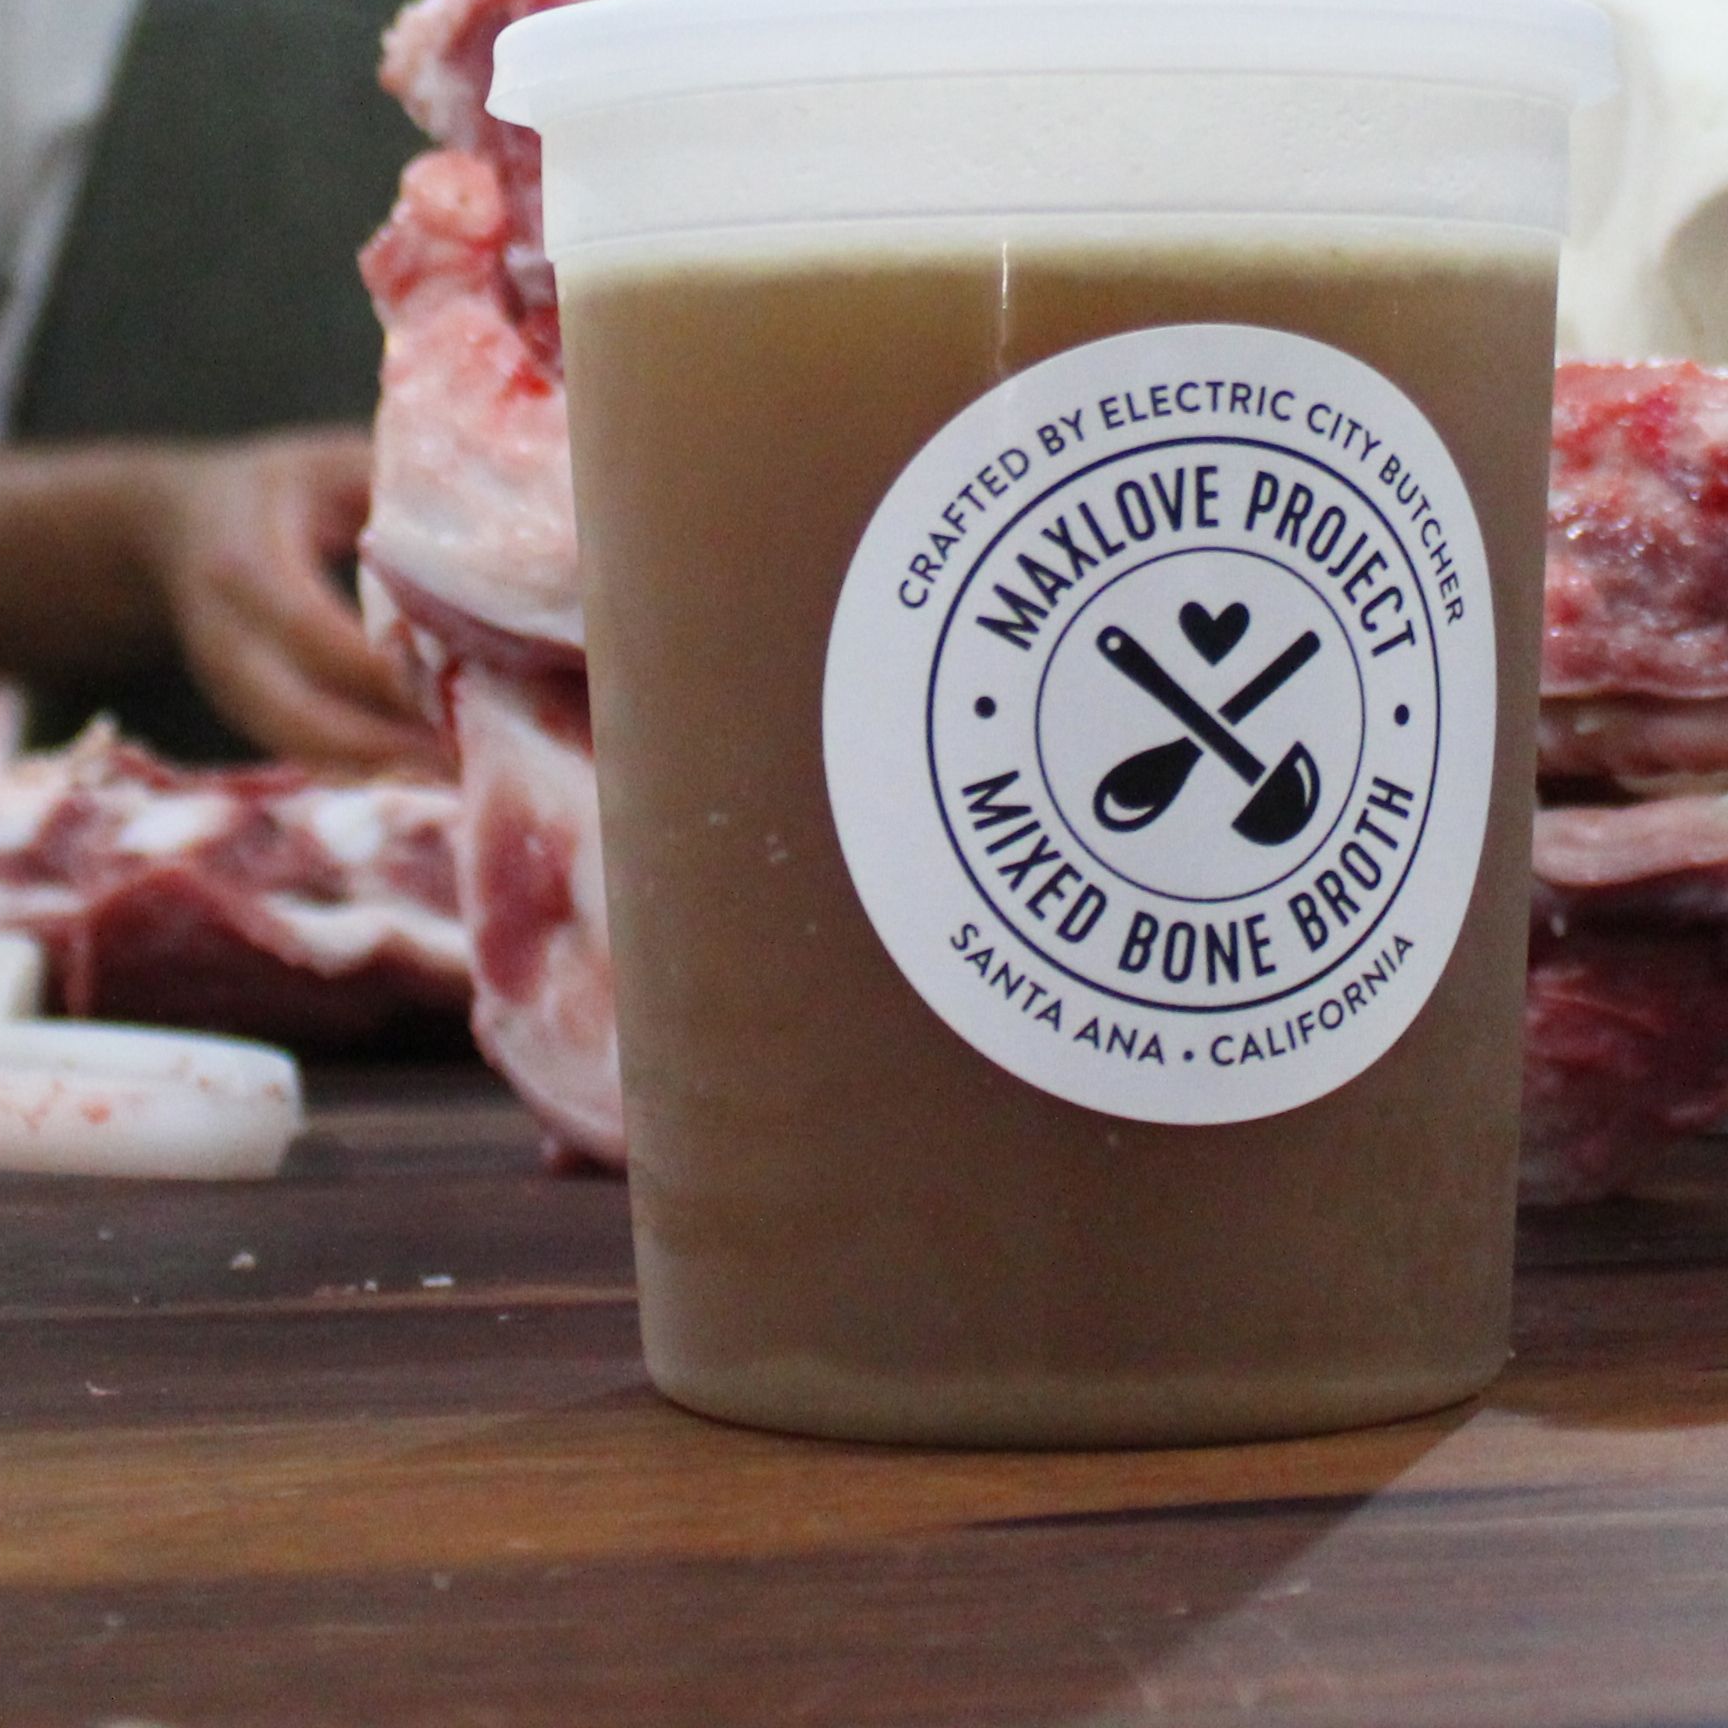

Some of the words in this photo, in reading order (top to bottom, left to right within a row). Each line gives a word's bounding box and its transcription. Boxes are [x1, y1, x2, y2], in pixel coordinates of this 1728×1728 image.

[898, 448, 1030, 609] CRAFTED
[1036, 408, 1084, 457] BY
[1098, 380, 1295, 430] ELECTRIC
[1306, 402, 1382, 462] CITY
[1378, 453, 1464, 625] BUTCHER
[975, 464, 1219, 651] MAXLOVE
[1244, 470, 1420, 658] PROJECT
[961, 769, 1108, 944] MIXED
[1117, 910, 1277, 986] BONE
[1287, 776, 1415, 953] BROTH
[950, 922, 1063, 1032] SANTA
[1073, 1016, 1165, 1065] ANA
[1209, 935, 1414, 1067] CALIFORNIA
